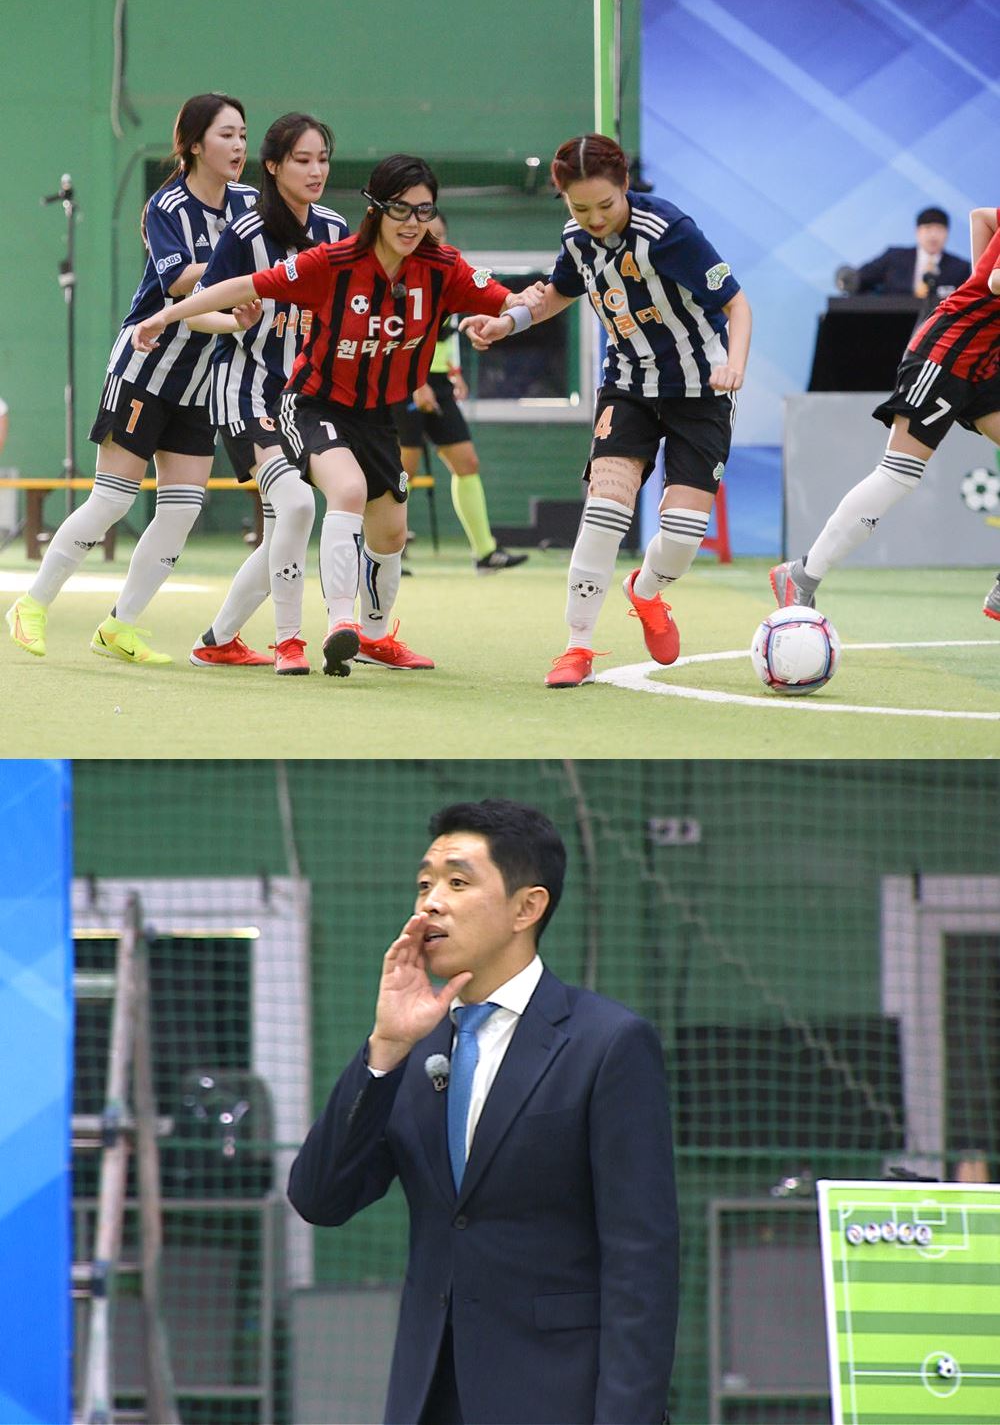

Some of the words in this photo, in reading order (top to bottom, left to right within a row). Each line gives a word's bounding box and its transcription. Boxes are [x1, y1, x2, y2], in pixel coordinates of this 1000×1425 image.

[165, 253, 182, 265] SBS
[287, 263, 297, 280] SBS
[620, 251, 641, 282] 4
[409, 287, 423, 320] 1
[591, 288, 625, 311] FC
[368, 316, 405, 339] FC
[126, 398, 144, 434] 1
[594, 405, 614, 440] 4
[921, 397, 952, 426] 7
[320, 421, 337, 440] 1
